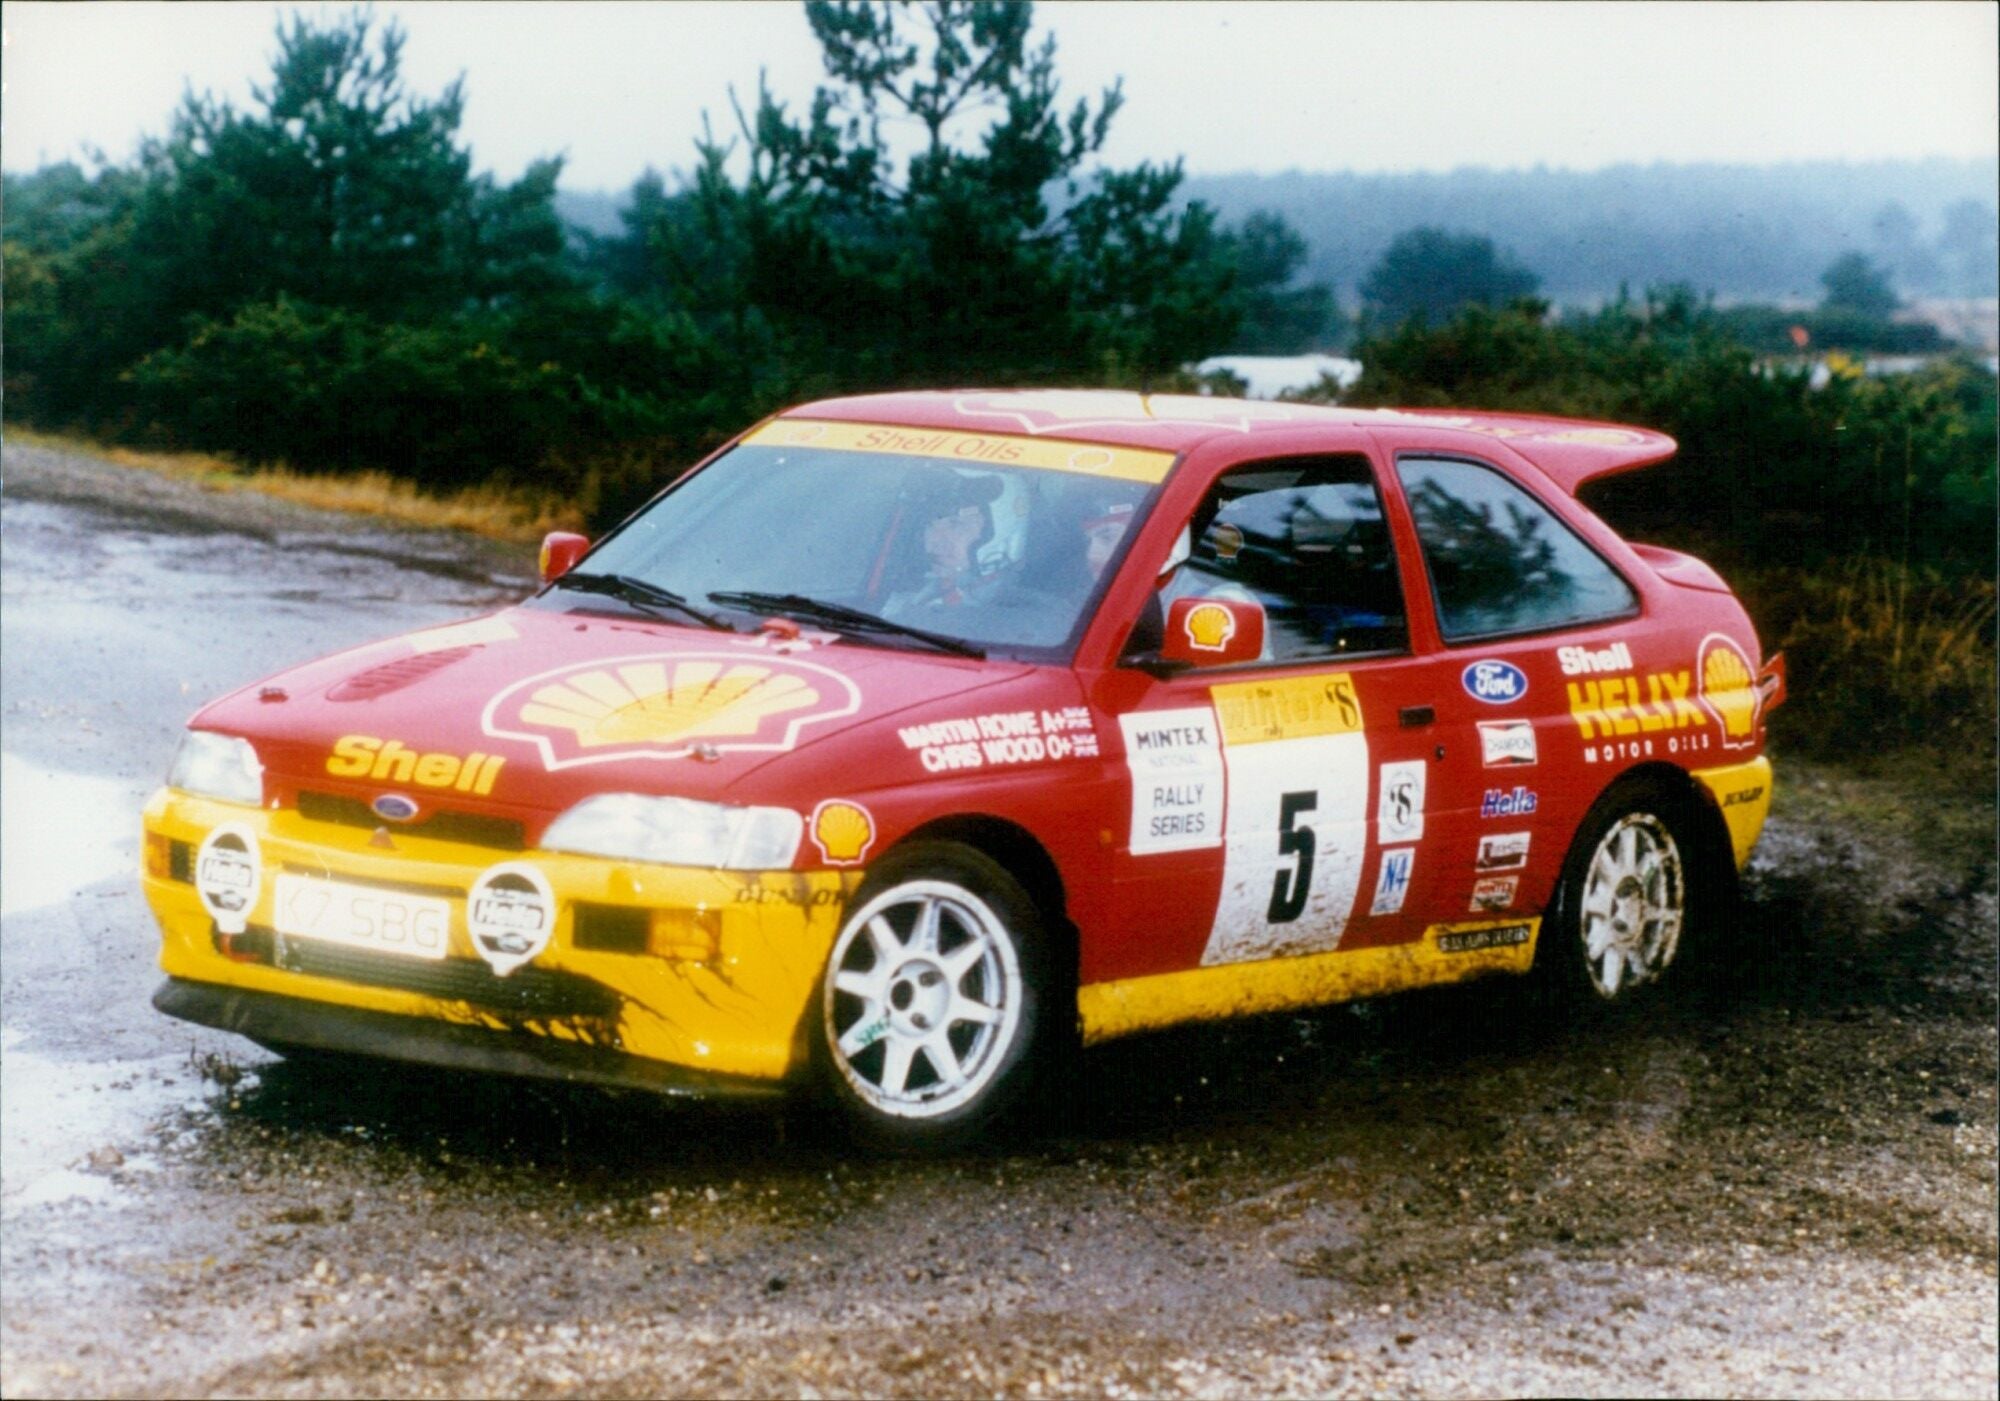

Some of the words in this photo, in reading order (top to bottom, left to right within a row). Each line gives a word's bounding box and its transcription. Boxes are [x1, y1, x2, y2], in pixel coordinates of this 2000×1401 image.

[855, 430, 950, 451] Shell
[954, 438, 1024, 460] Oils
[1556, 642, 1633, 675] Shell
[1475, 664, 1515, 695] Ford
[1567, 671, 1706, 739] HELIX
[898, 719, 981, 749] MARTIN
[977, 712, 1041, 738] ROWE
[1136, 728, 1208, 749] MINTEX
[921, 742, 984, 772] CHRIS
[982, 737, 1044, 764] WOOD
[1584, 740, 1652, 763] MOTOR
[1668, 733, 1709, 753] OILS
[326, 735, 507, 796] Shell
[1154, 784, 1204, 808] RALLY
[1480, 787, 1538, 818] Hella
[1150, 811, 1205, 837] SERIES
[1267, 790, 1318, 924] 5
[350, 897, 440, 948] SBG
